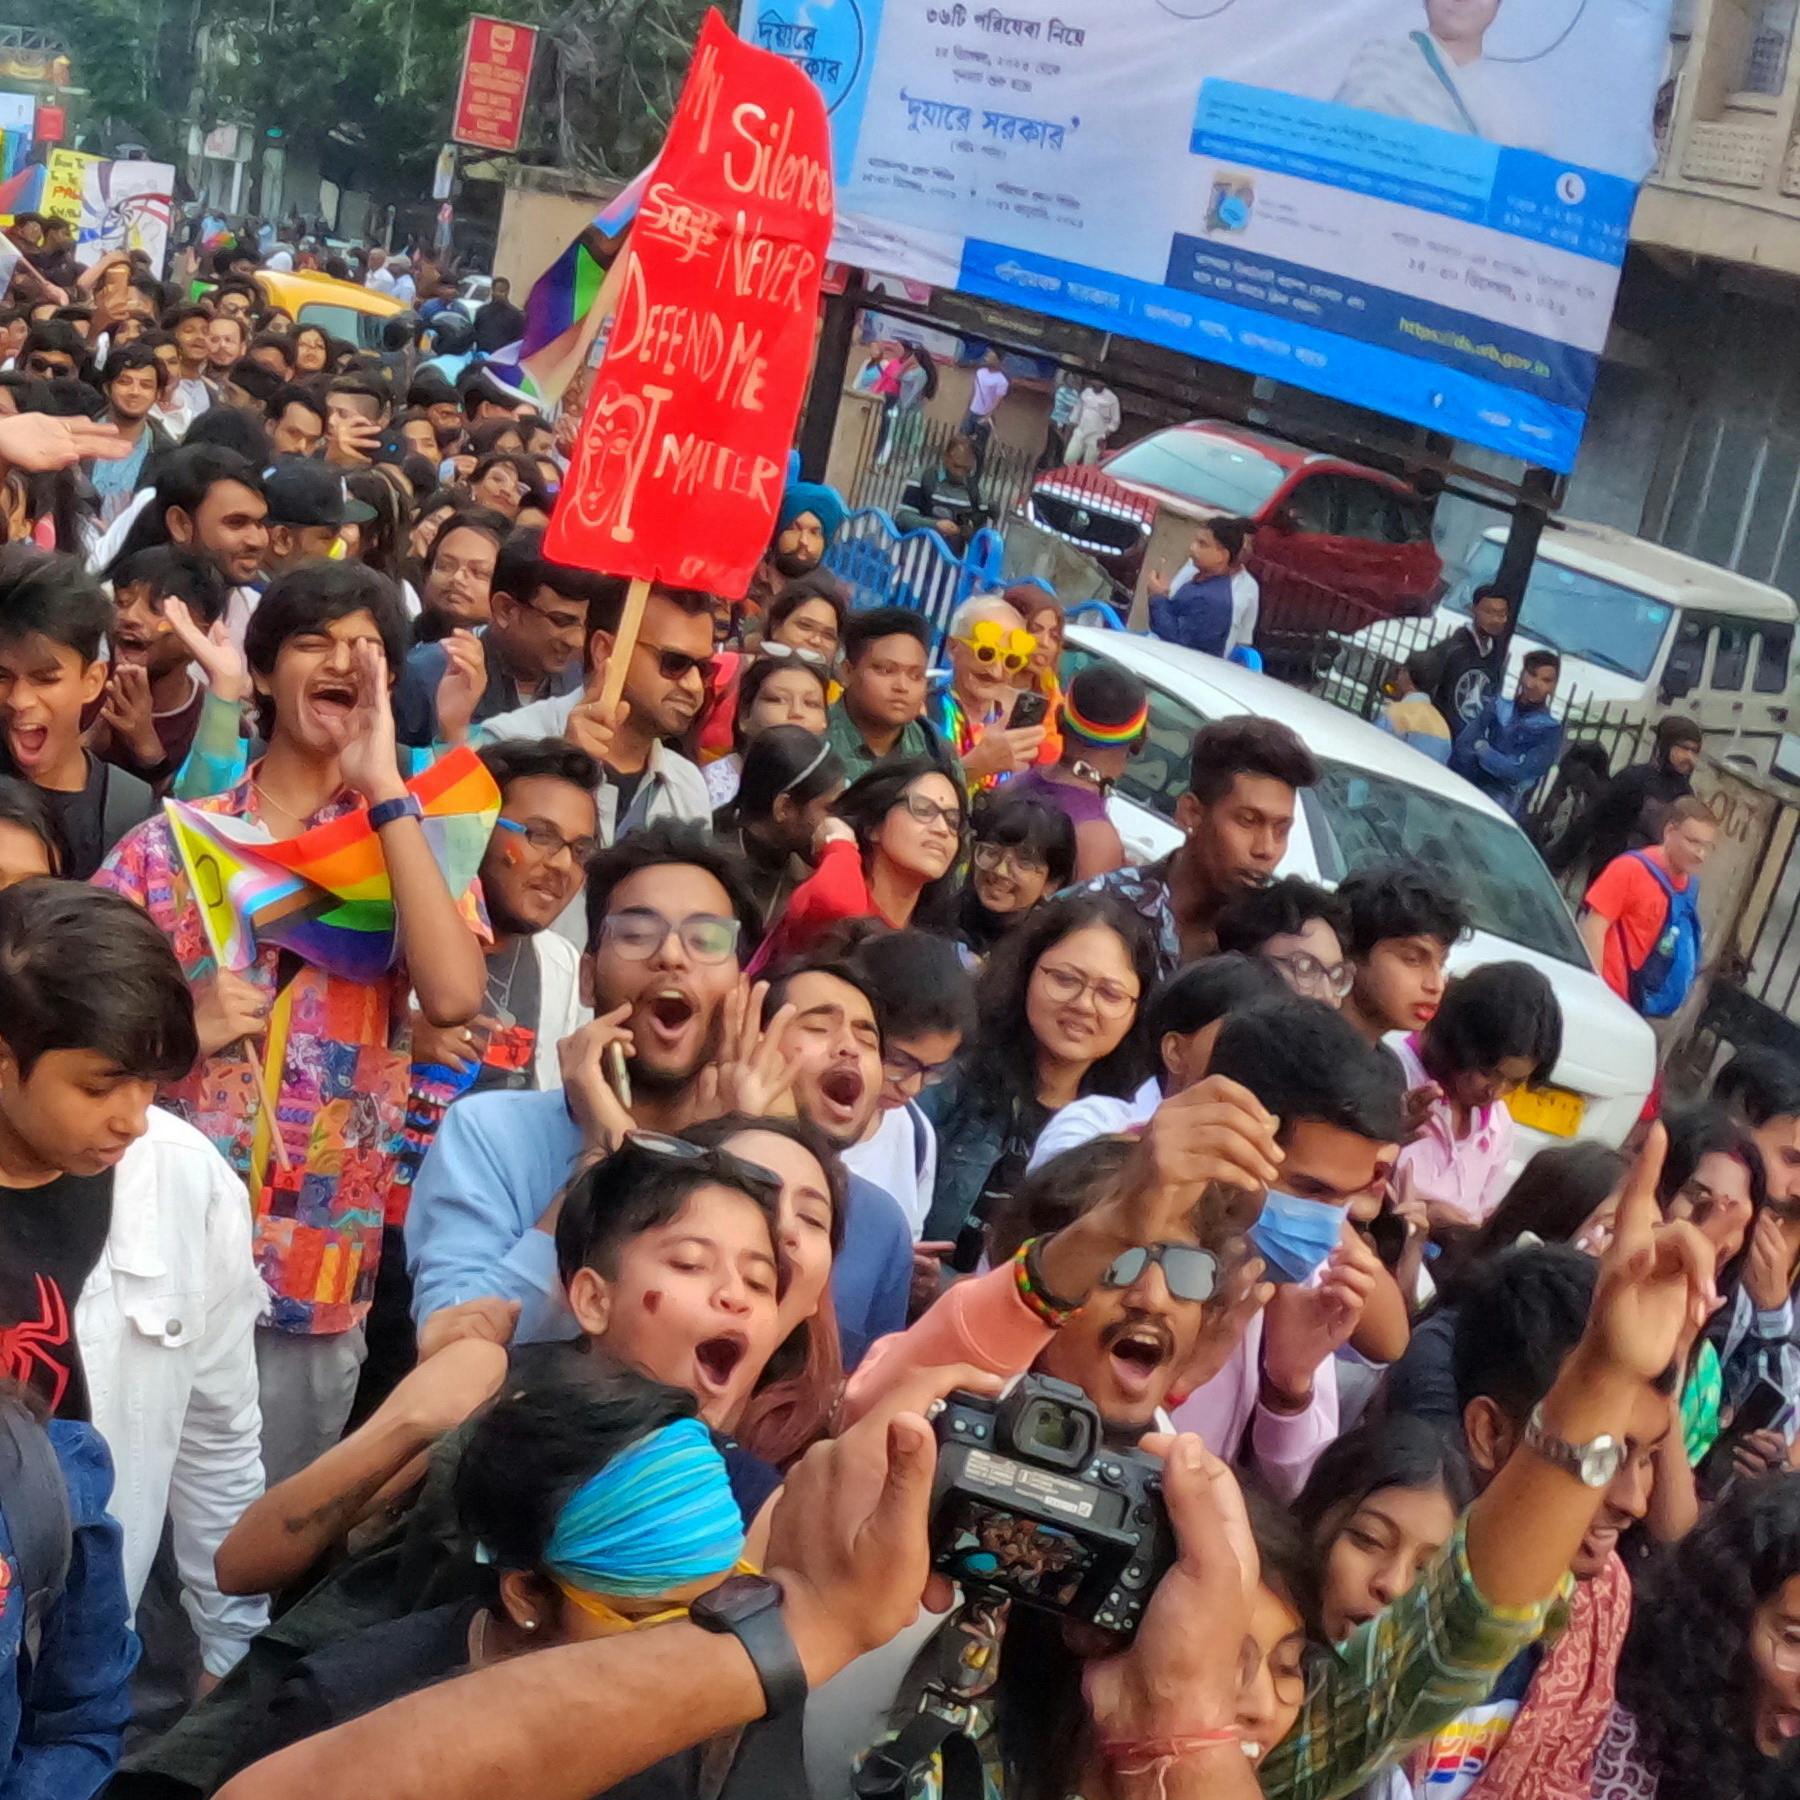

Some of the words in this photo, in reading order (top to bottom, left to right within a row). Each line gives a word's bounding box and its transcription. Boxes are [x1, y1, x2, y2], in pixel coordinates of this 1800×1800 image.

[723, 103, 833, 216] Silence
[715, 210, 816, 312] NEVER
[607, 250, 725, 383] DEFEND
[717, 322, 769, 412] ME
[653, 433, 780, 516] MATTER
